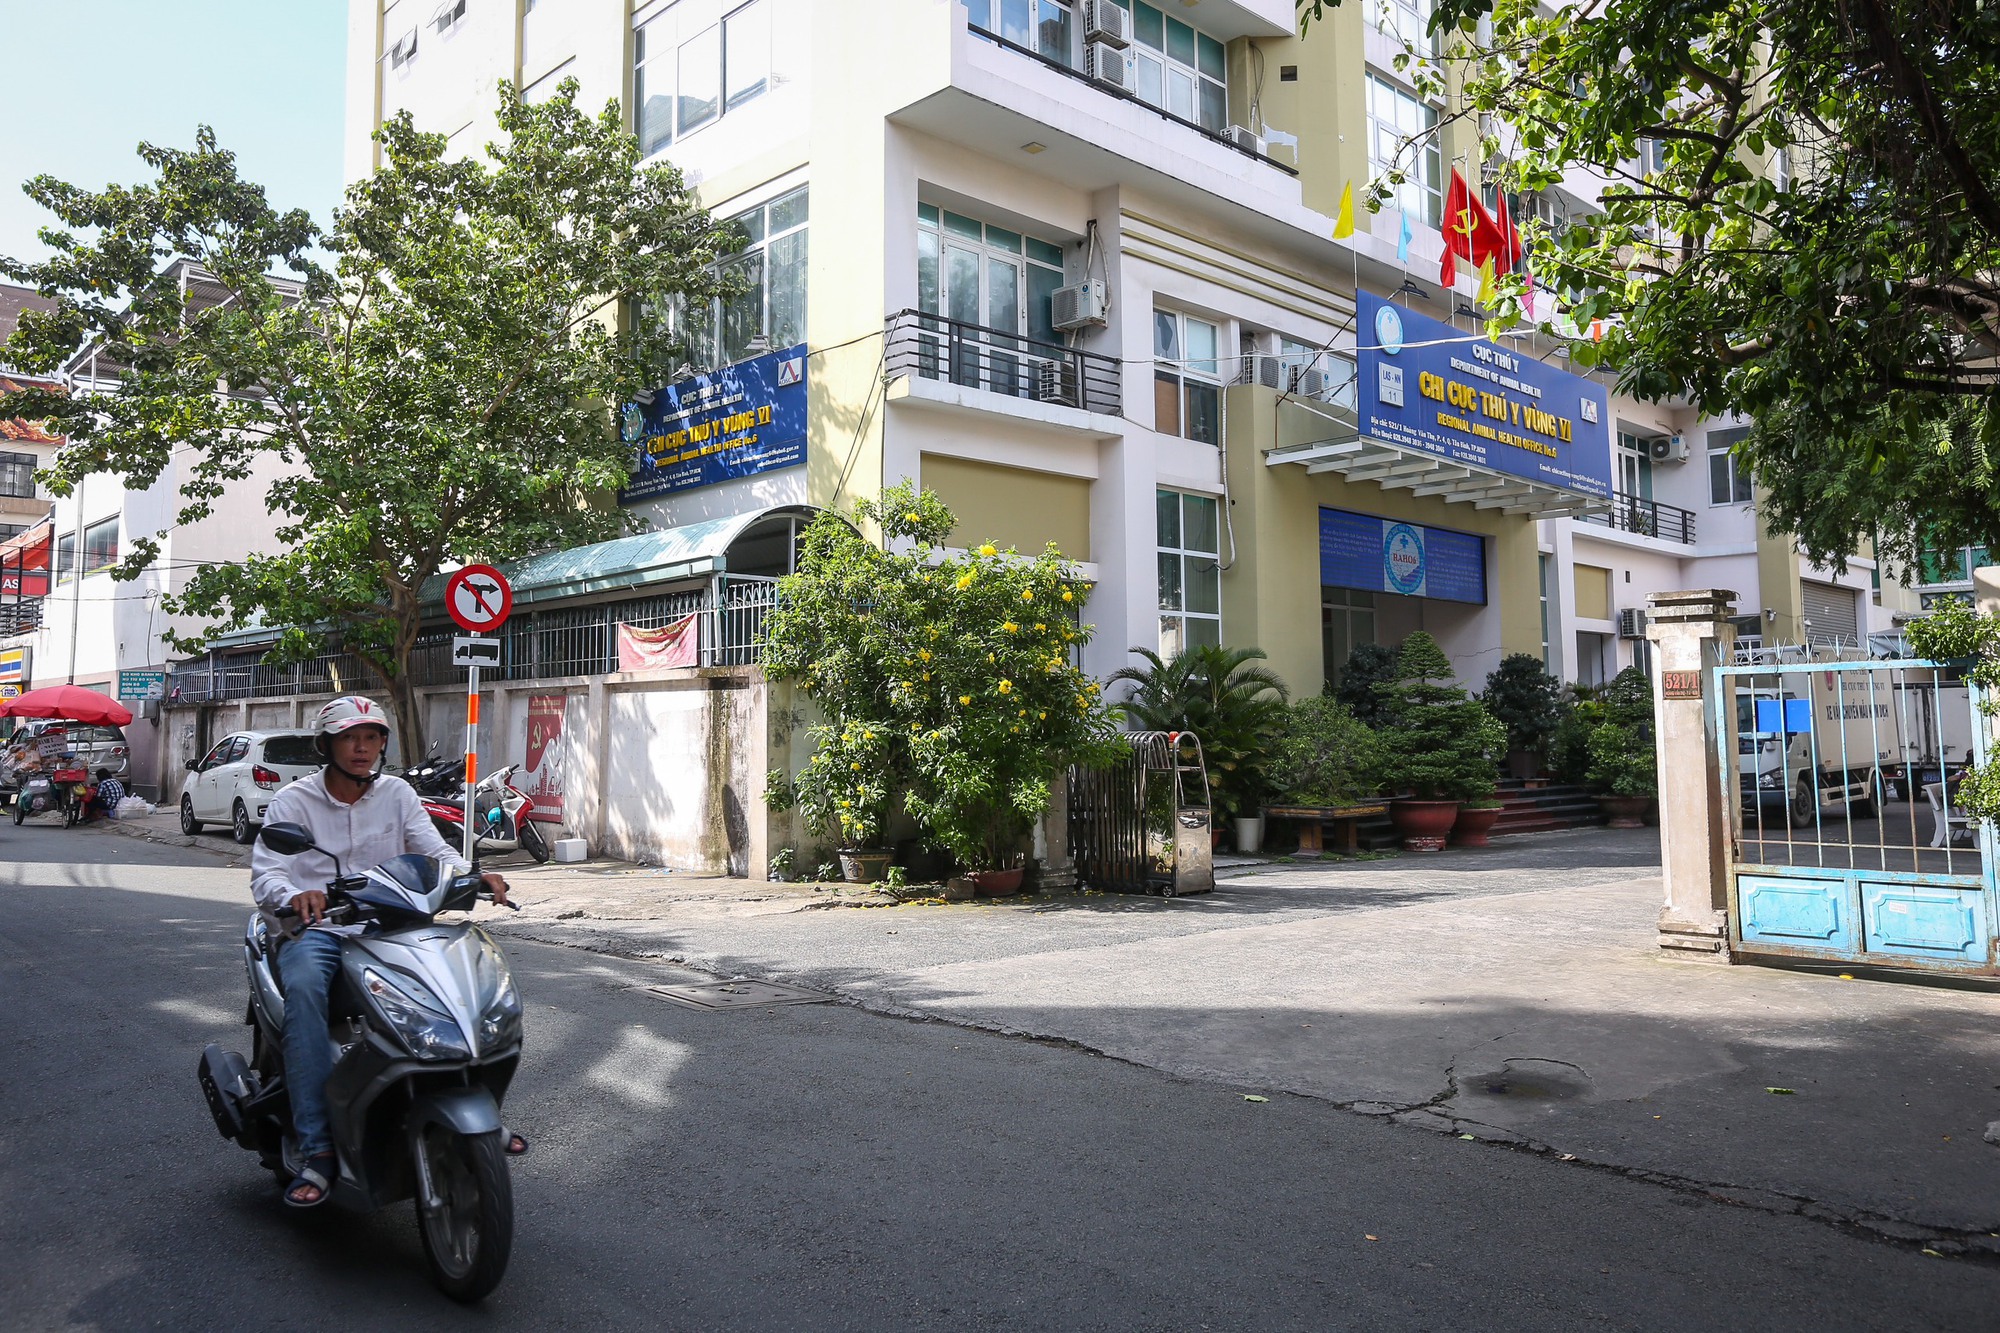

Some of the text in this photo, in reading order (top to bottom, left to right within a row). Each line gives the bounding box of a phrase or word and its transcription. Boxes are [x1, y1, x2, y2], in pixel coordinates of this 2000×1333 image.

[1472, 344, 1520, 373] CỤC THÚ Y
[1451, 357, 1542, 399] DEPARTMENT OF ANIMAL HEALTH
[682, 383, 722, 406] CỤC THÚ Y
[1419, 371, 1572, 443] CHI CỤC THÚ Y VÙNG VI
[665, 430, 687, 451] CỤC
[688, 419, 710, 443] THÚ
[712, 420, 720, 437] Y
[723, 411, 755, 434] VÙNG
[757, 405, 771, 425] VI
[1437, 412, 1558, 459] REGIONAL ANIMAL HEALTH OFFICE No.6
[723, 438, 743, 450] OFFICE
[1393, 553, 1417, 564] RAHO6
[1666, 673, 1698, 689] 521/1
[1826, 705, 1833, 720] XE
